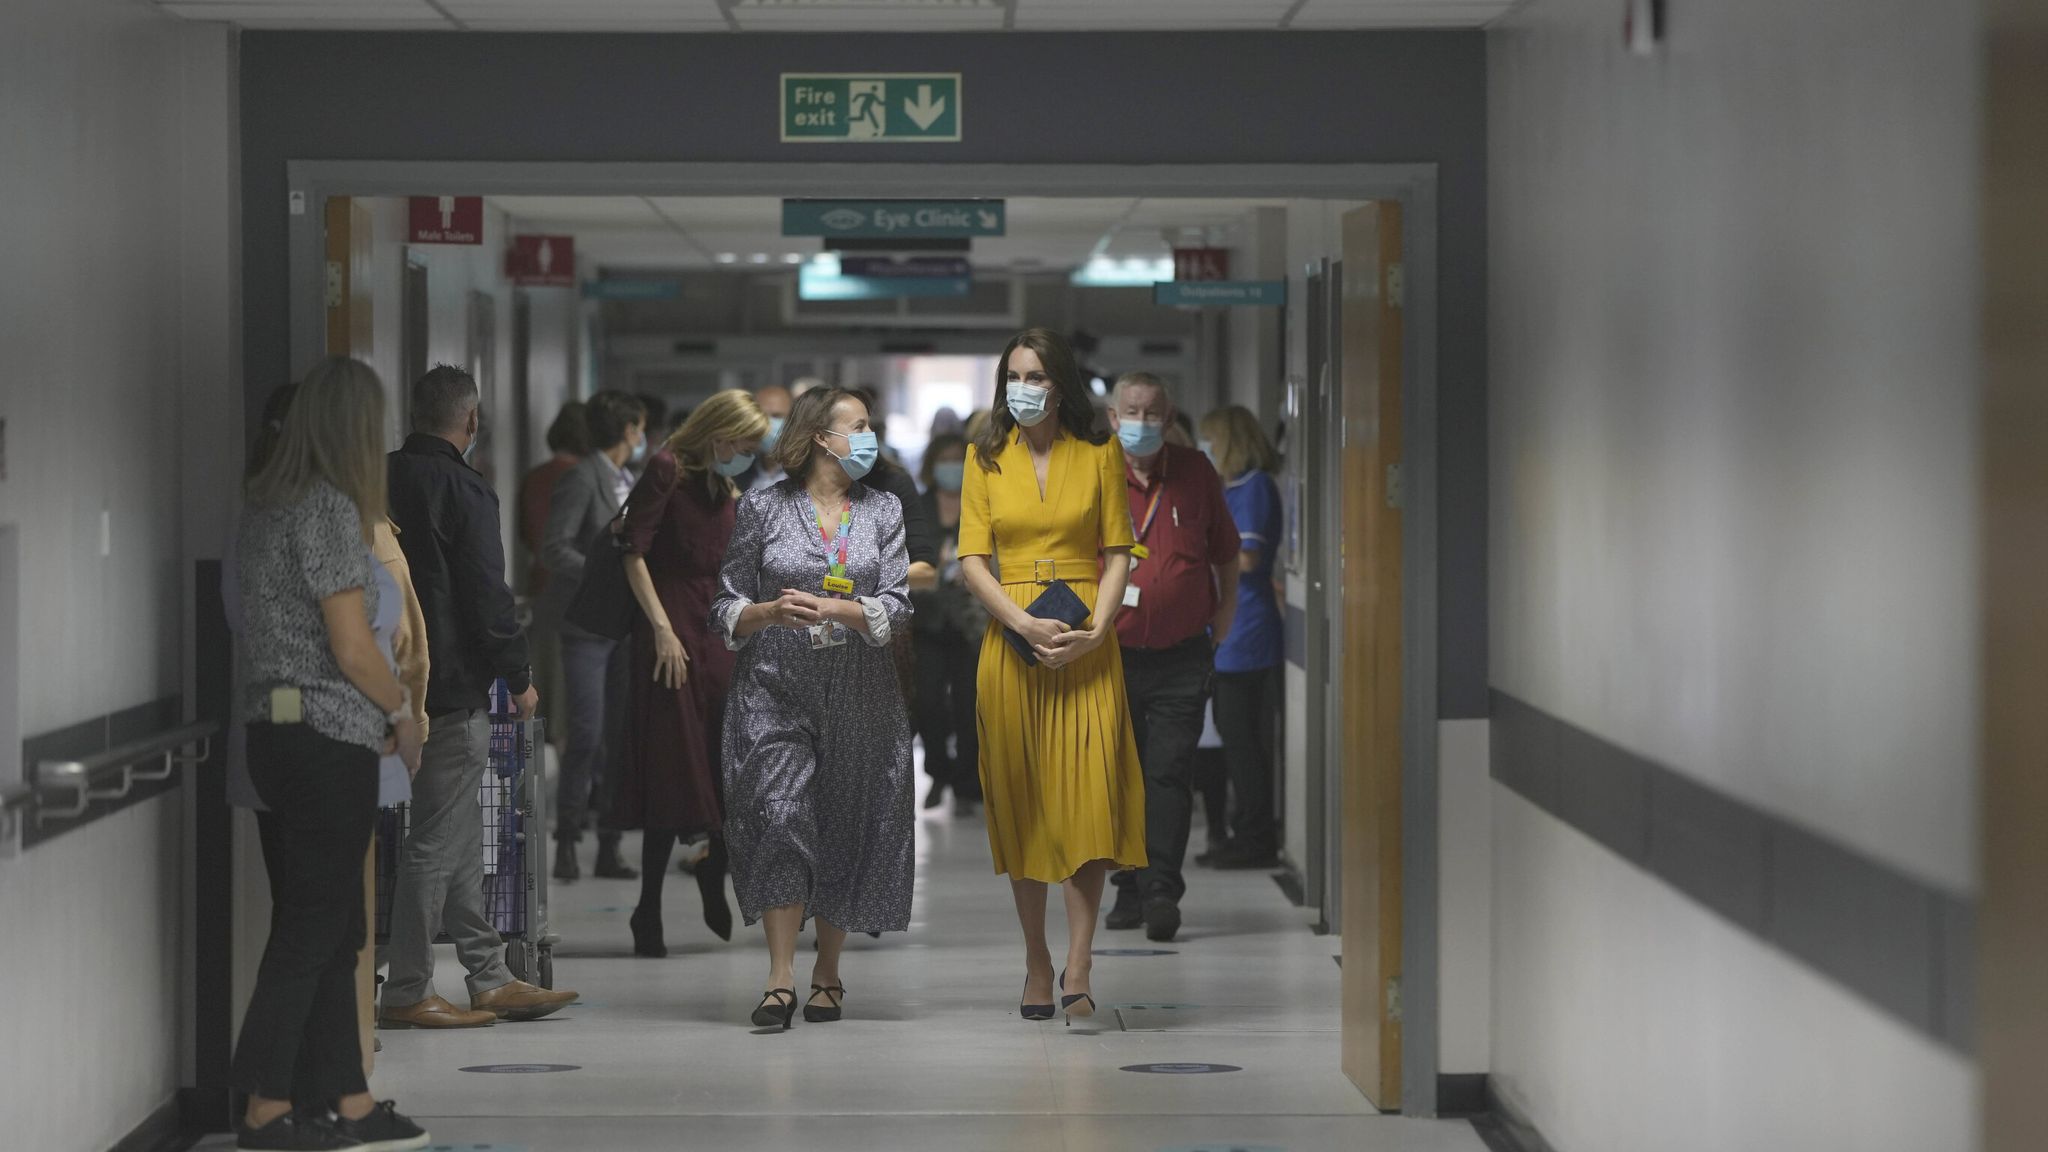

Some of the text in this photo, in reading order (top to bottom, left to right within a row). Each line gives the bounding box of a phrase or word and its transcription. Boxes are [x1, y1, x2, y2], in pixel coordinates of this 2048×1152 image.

[795, 86, 836, 105] Fire
[795, 108, 836, 126] exit
[874, 208, 971, 231] Eye Clinic
[417, 230, 474, 242] Male Toilets
[827, 582, 849, 590] Louise
